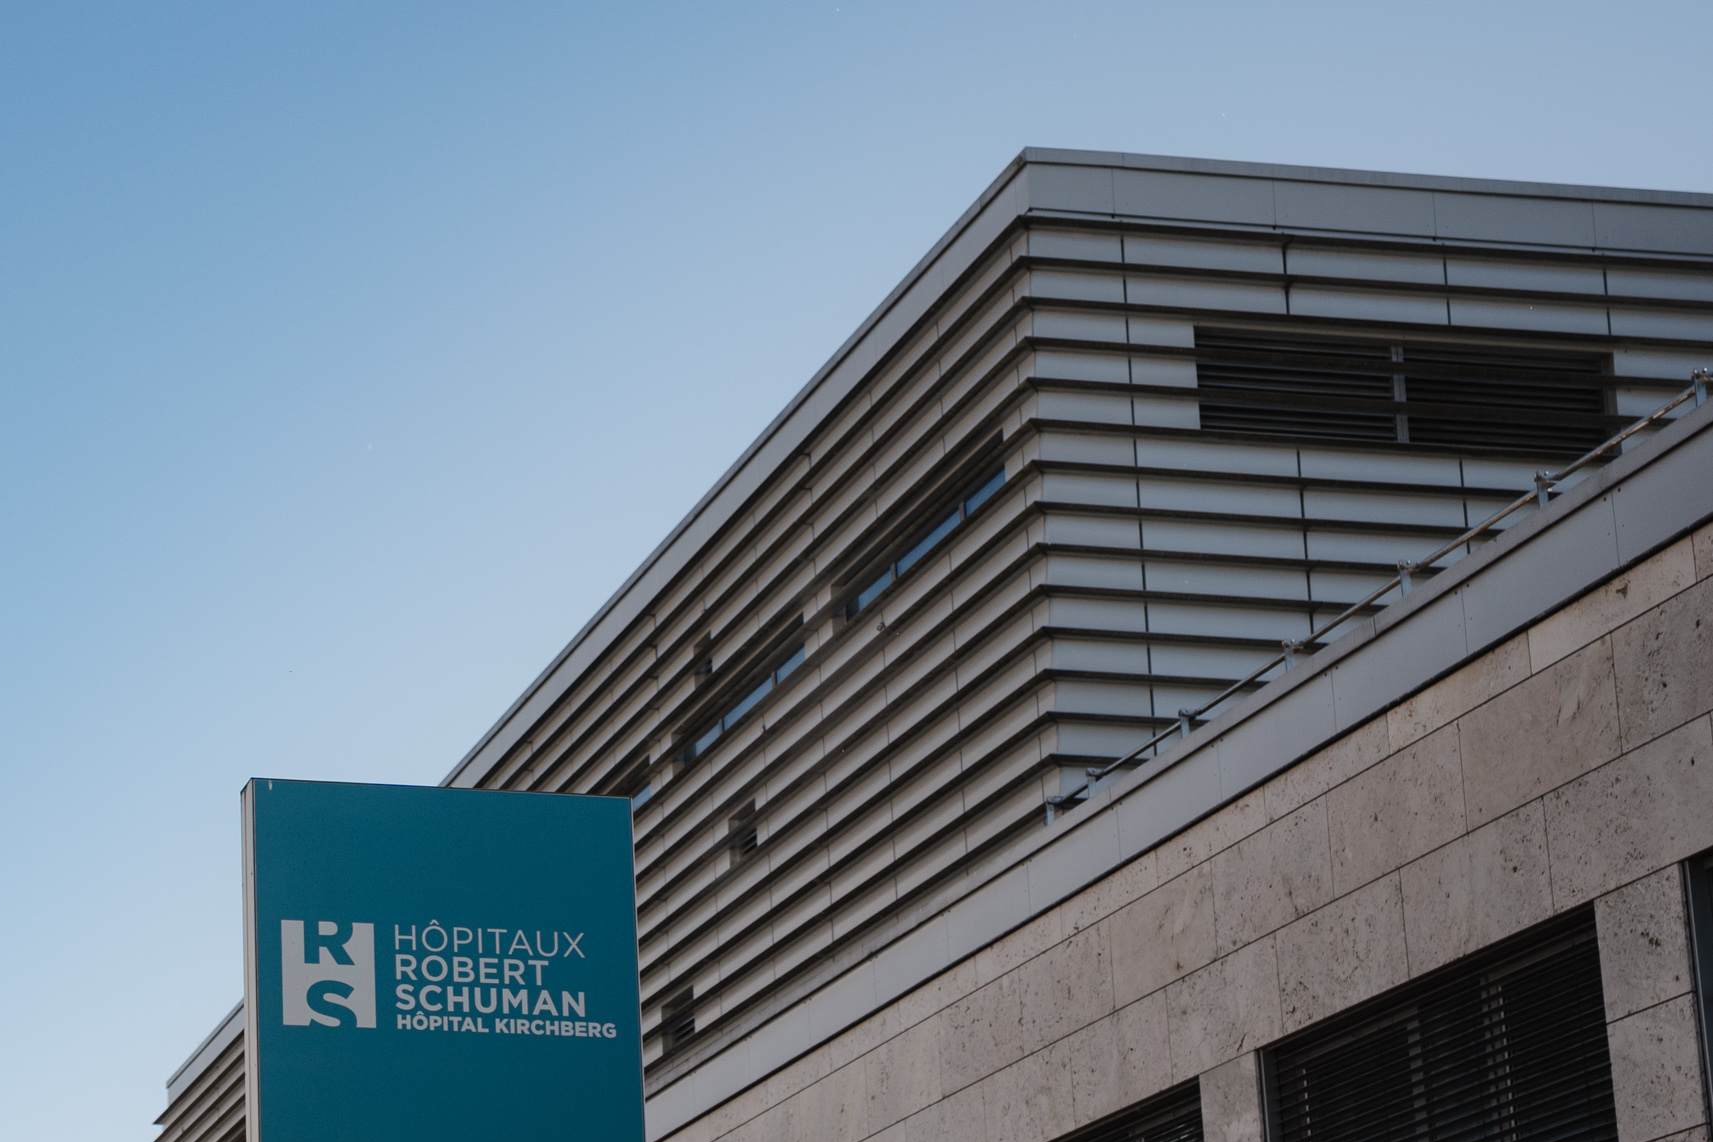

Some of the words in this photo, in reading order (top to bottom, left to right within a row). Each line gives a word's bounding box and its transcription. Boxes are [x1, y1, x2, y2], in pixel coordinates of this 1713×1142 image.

[394, 919, 586, 958] HÔPITAUX
[395, 954, 549, 986] ROBERT
[395, 983, 586, 1018] SCHUMAN
[396, 1010, 490, 1034] HÔPITAL
[494, 1018, 618, 1039] KIRCHBERG
